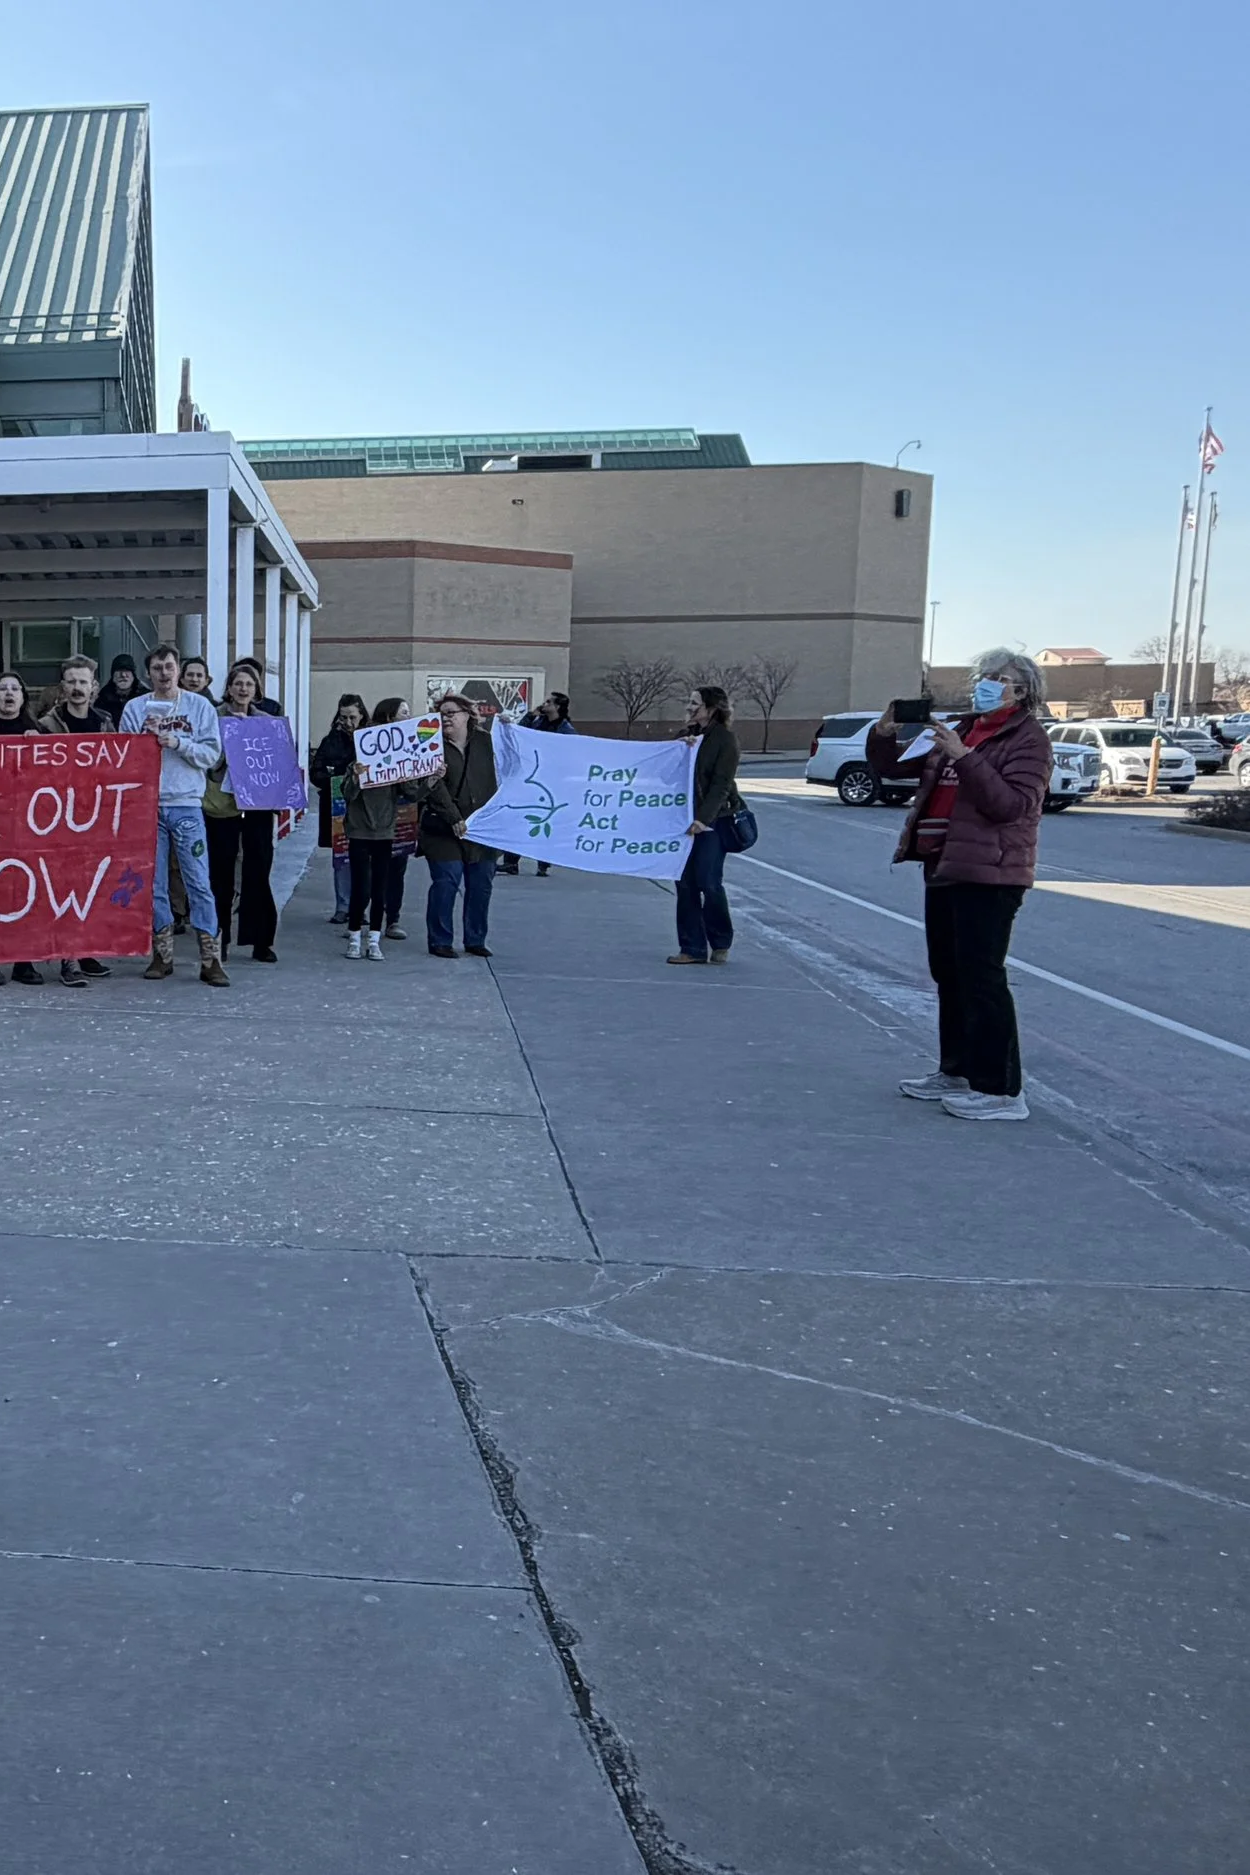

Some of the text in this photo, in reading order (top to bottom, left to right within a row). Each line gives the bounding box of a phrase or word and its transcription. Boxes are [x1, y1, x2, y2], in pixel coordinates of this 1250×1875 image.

[242, 737, 273, 752] ICE
[359, 727, 405, 756] GOD
[75, 740, 130, 768] SAY
[245, 754, 274, 769] OUT
[249, 771, 280, 787] NOW
[588, 764, 638, 786] Pray
[583, 789, 687, 808] for Peace
[27, 783, 143, 838] OUT
[578, 812, 619, 830] Act
[575, 835, 681, 854] for Peace
